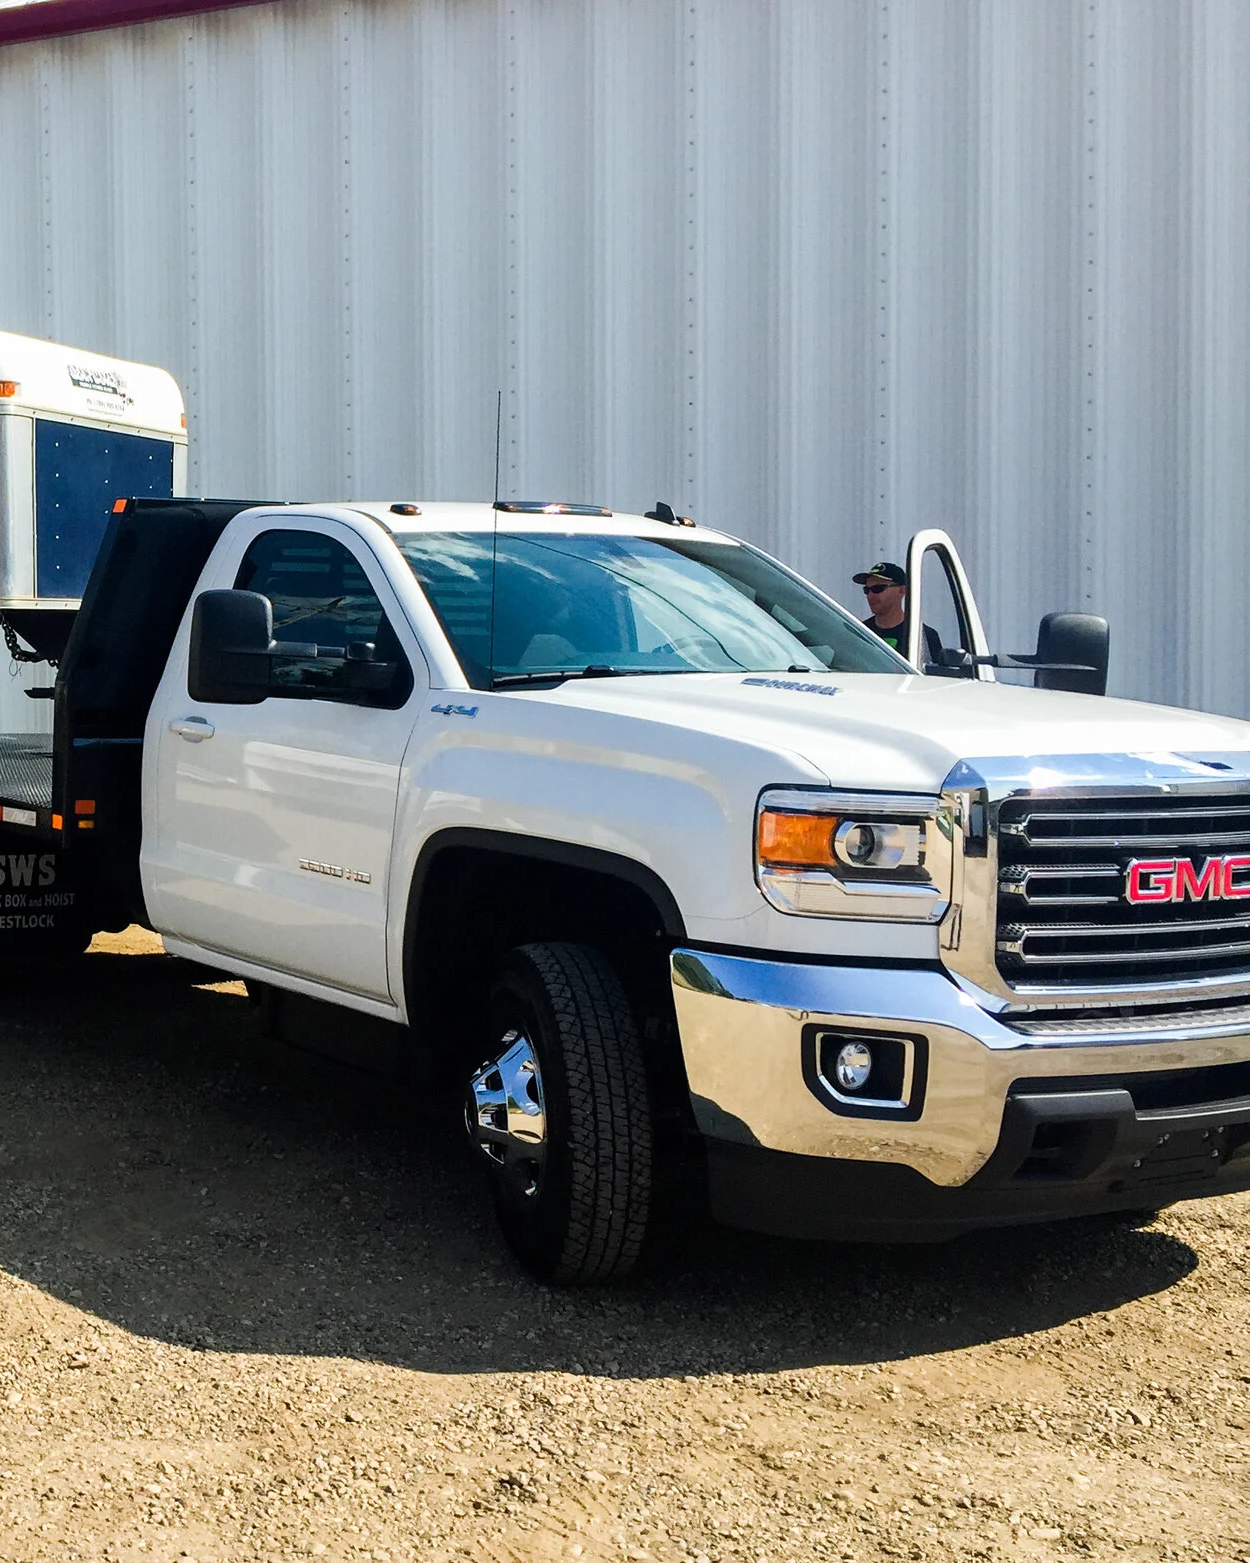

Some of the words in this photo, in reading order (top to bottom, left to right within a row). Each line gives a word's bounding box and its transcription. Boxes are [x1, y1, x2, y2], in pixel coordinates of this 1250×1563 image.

[4, 894, 27, 908] BOX
[29, 897, 43, 907] and
[44, 893, 76, 907] HOIST
